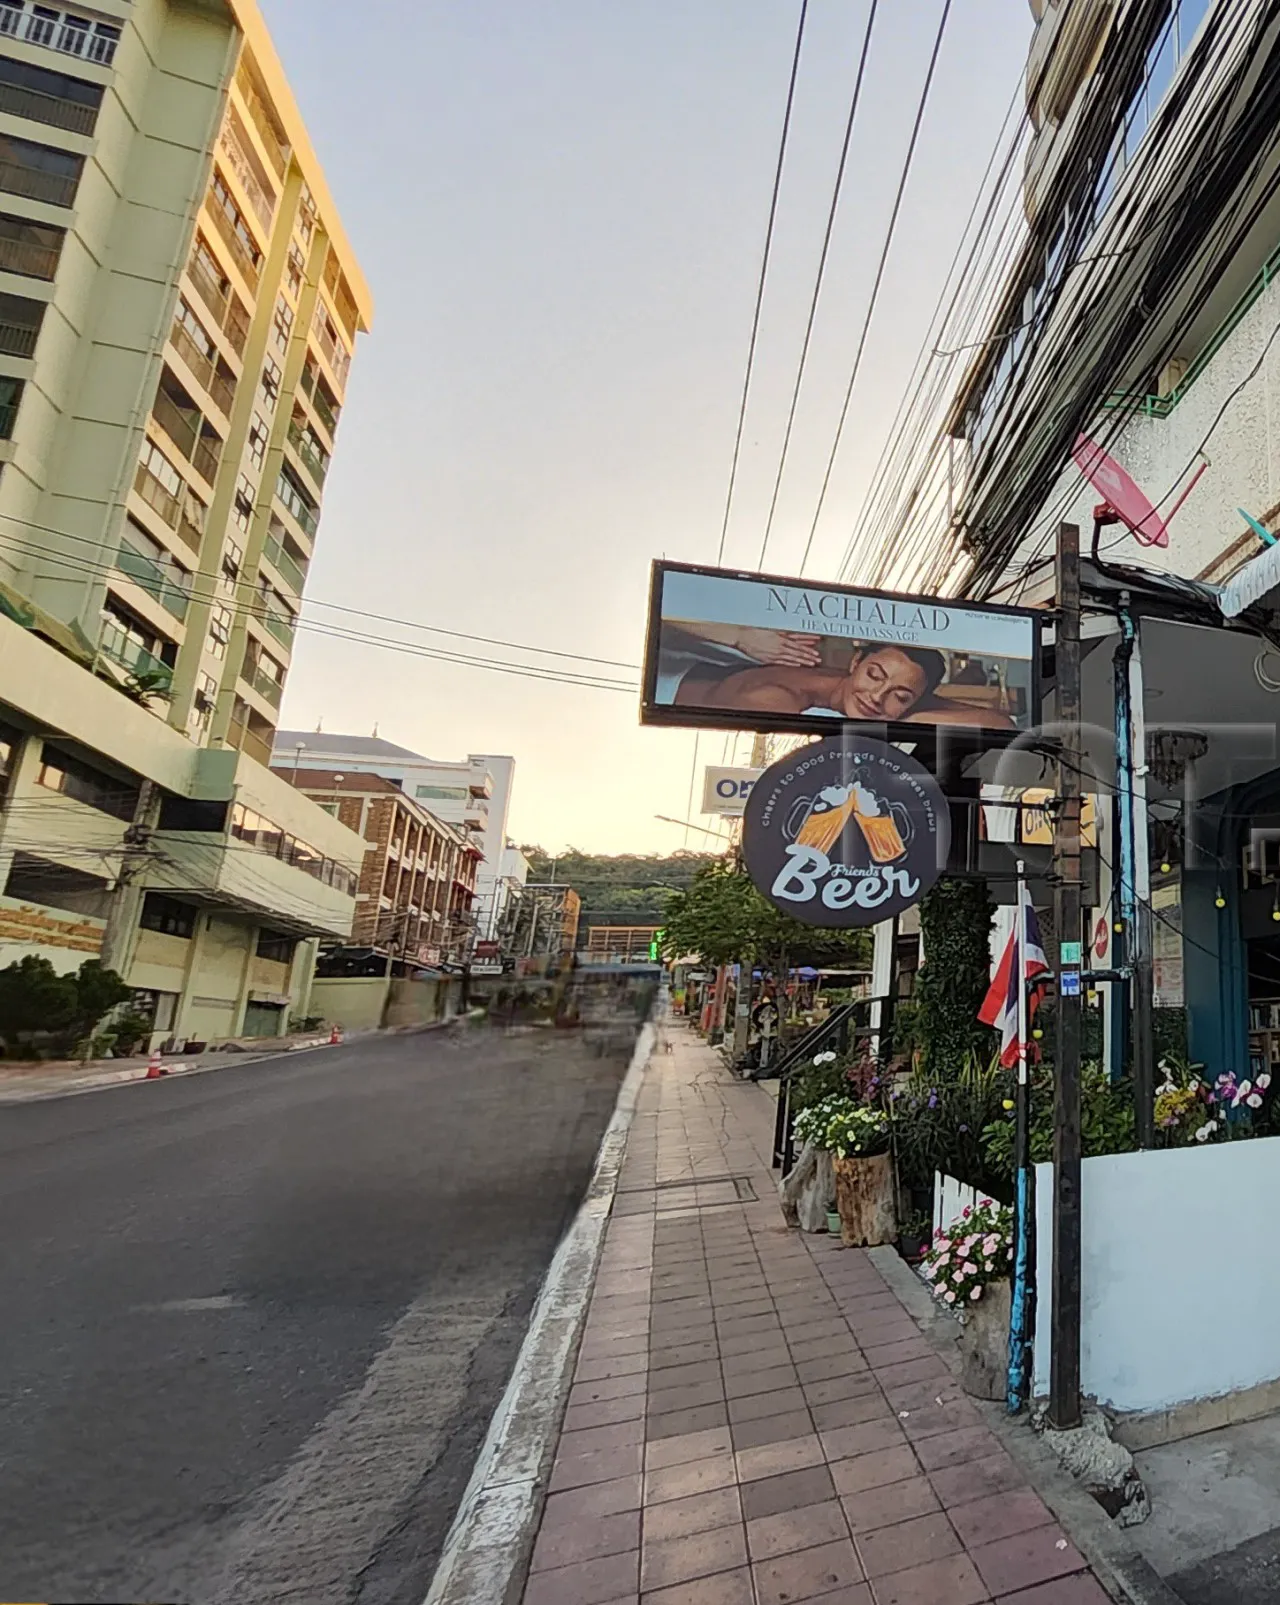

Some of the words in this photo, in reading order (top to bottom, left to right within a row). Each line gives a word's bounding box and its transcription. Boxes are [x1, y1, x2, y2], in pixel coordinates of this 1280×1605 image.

[766, 588, 950, 631] NACHALAD
[801, 619, 854, 637] HEALTH
[858, 627, 919, 642] MASSAGE
[762, 787, 781, 827] cheers
[780, 774, 794, 786] to
[796, 754, 824, 776] good
[829, 751, 874, 762] friends
[878, 757, 900, 772] and
[899, 772, 925, 798] great
[922, 800, 936, 833] brews
[771, 843, 920, 909] Beer
[829, 860, 879, 877] Friends
